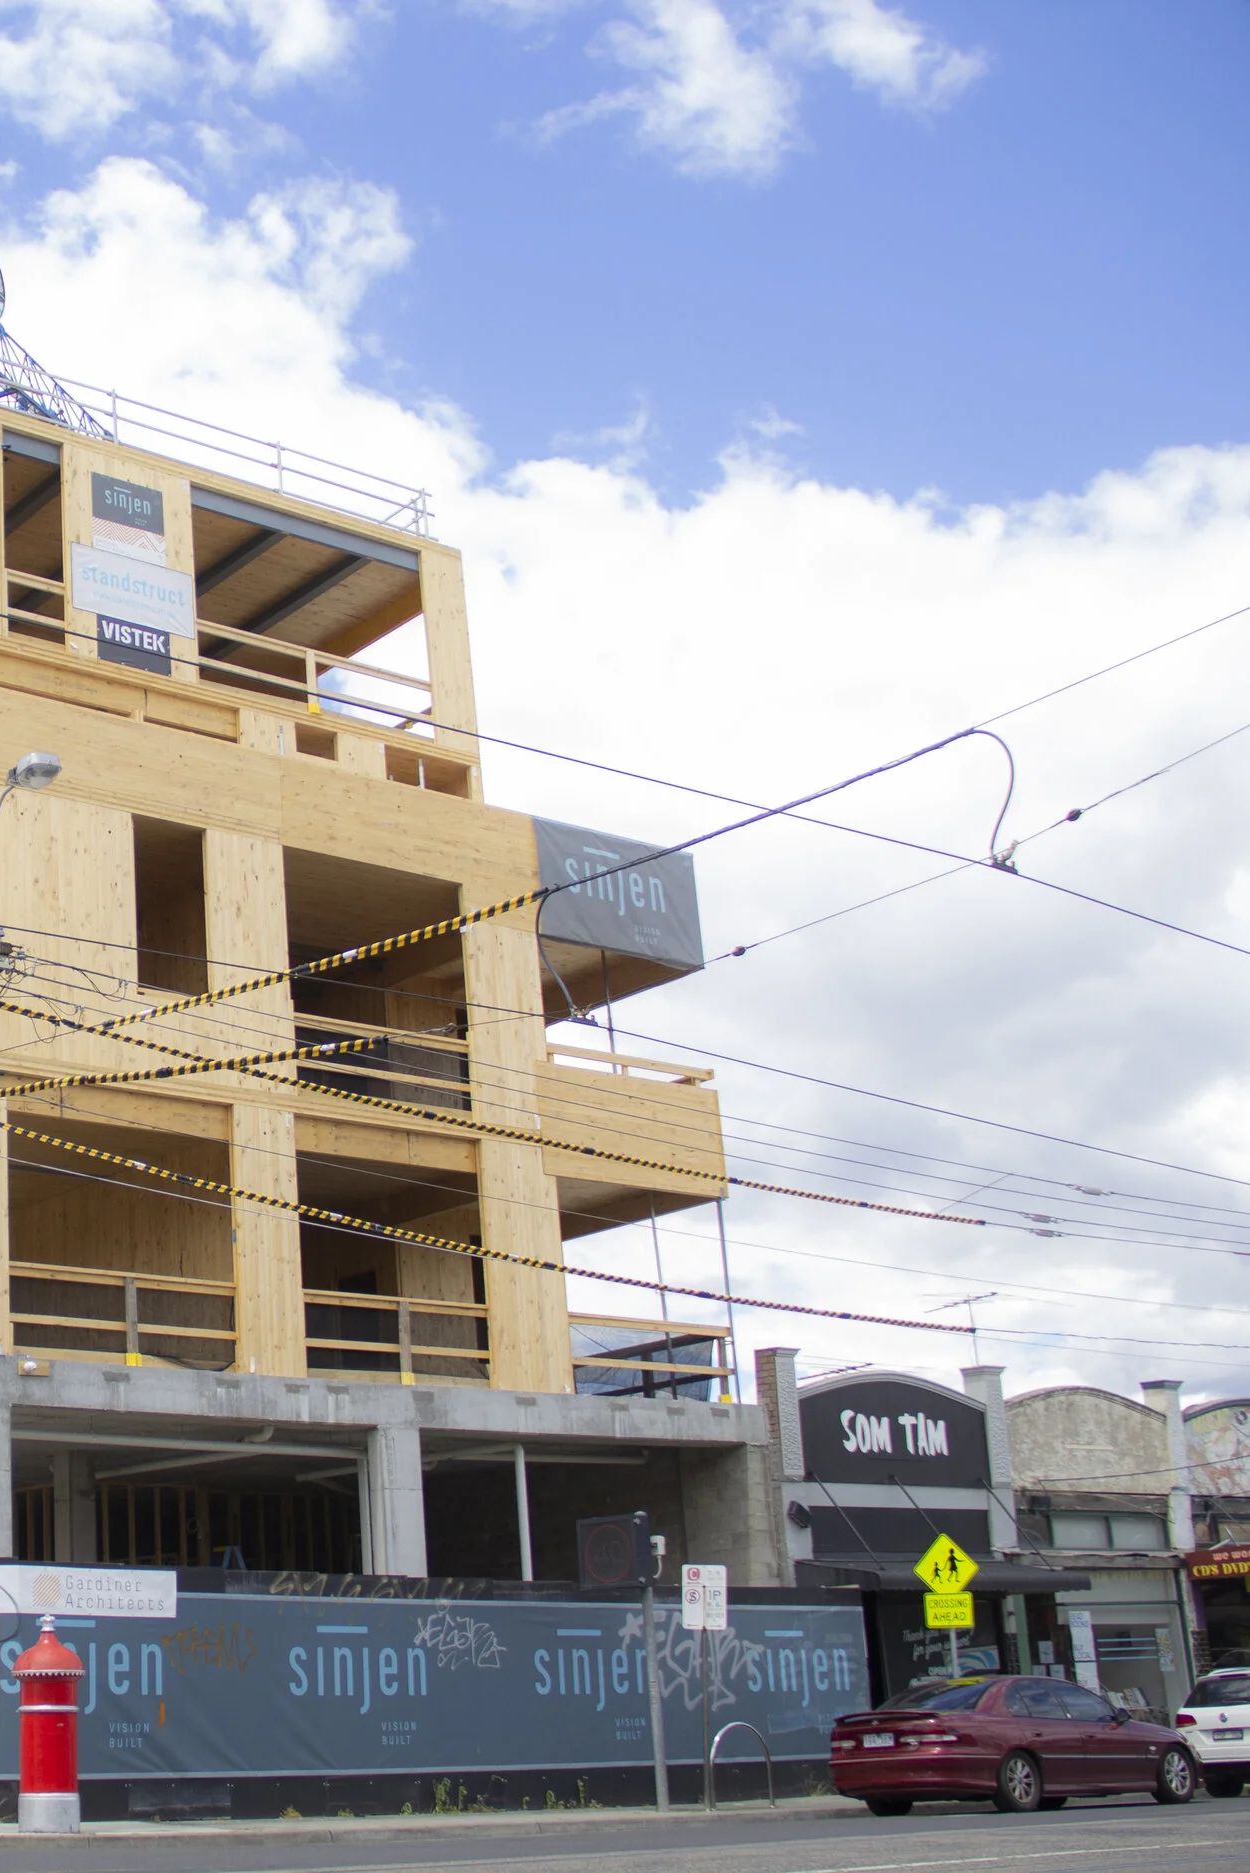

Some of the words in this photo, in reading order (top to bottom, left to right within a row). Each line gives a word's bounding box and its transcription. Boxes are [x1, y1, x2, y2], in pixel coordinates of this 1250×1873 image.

[104, 488, 151, 515] sinjen
[81, 565, 185, 606] standstruct
[101, 619, 165, 654] VISTEK
[565, 857, 666, 916] sinjen
[840, 1409, 892, 1453] SOM
[897, 1412, 949, 1456] TAM
[65, 1575, 142, 1592] Gardiner
[64, 1593, 165, 1611] Architects
[929, 1599, 968, 1609] CROSSING
[933, 1612, 966, 1621] AHEAD
[289, 1646, 427, 1714] sinjen
[747, 1648, 849, 1708] sinjen
[109, 1723, 150, 1733] VISION
[381, 1721, 417, 1731] VISION
[109, 1738, 142, 1748] BUILT
[381, 1735, 411, 1746] BUILT
